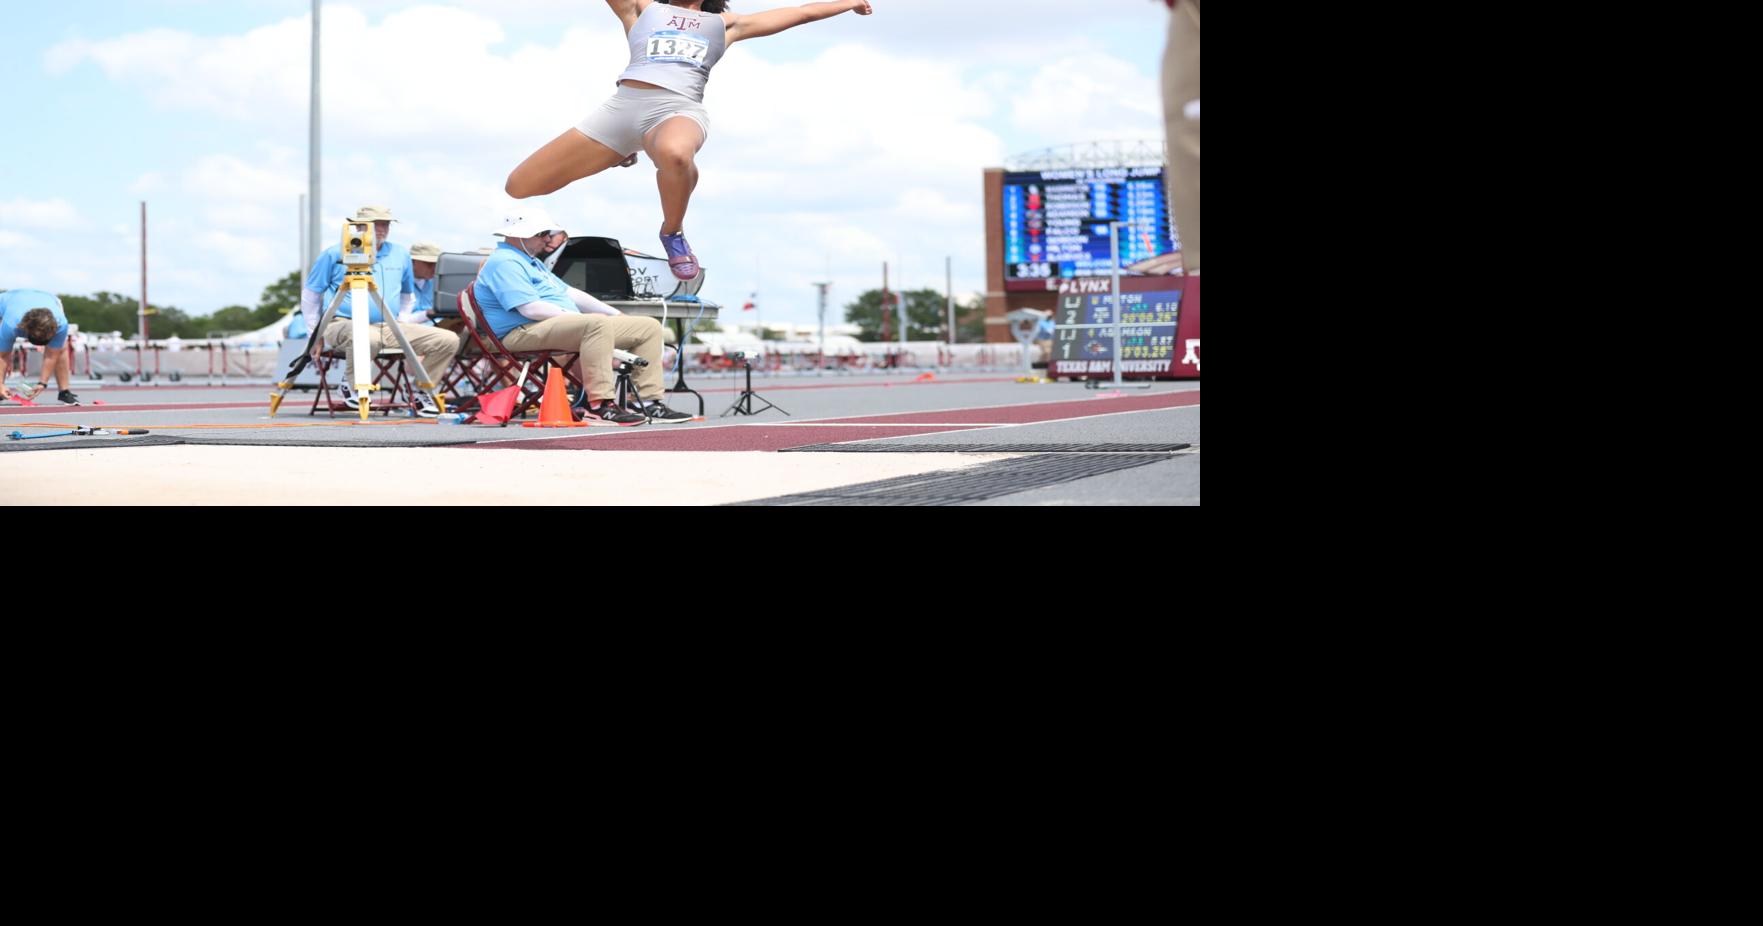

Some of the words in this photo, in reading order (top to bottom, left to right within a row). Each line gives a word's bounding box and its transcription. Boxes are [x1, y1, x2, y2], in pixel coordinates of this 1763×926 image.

[650, 40, 705, 58] 1327
[1096, 168, 1128, 178] LONG
[1070, 279, 1110, 293] LYNX
[1066, 311, 1077, 324] 2
[1062, 343, 1071, 360] 1
[1056, 360, 1087, 373] TEXAS
[1088, 360, 1111, 372] A&M
[1112, 360, 1171, 372] NIVERSITY
